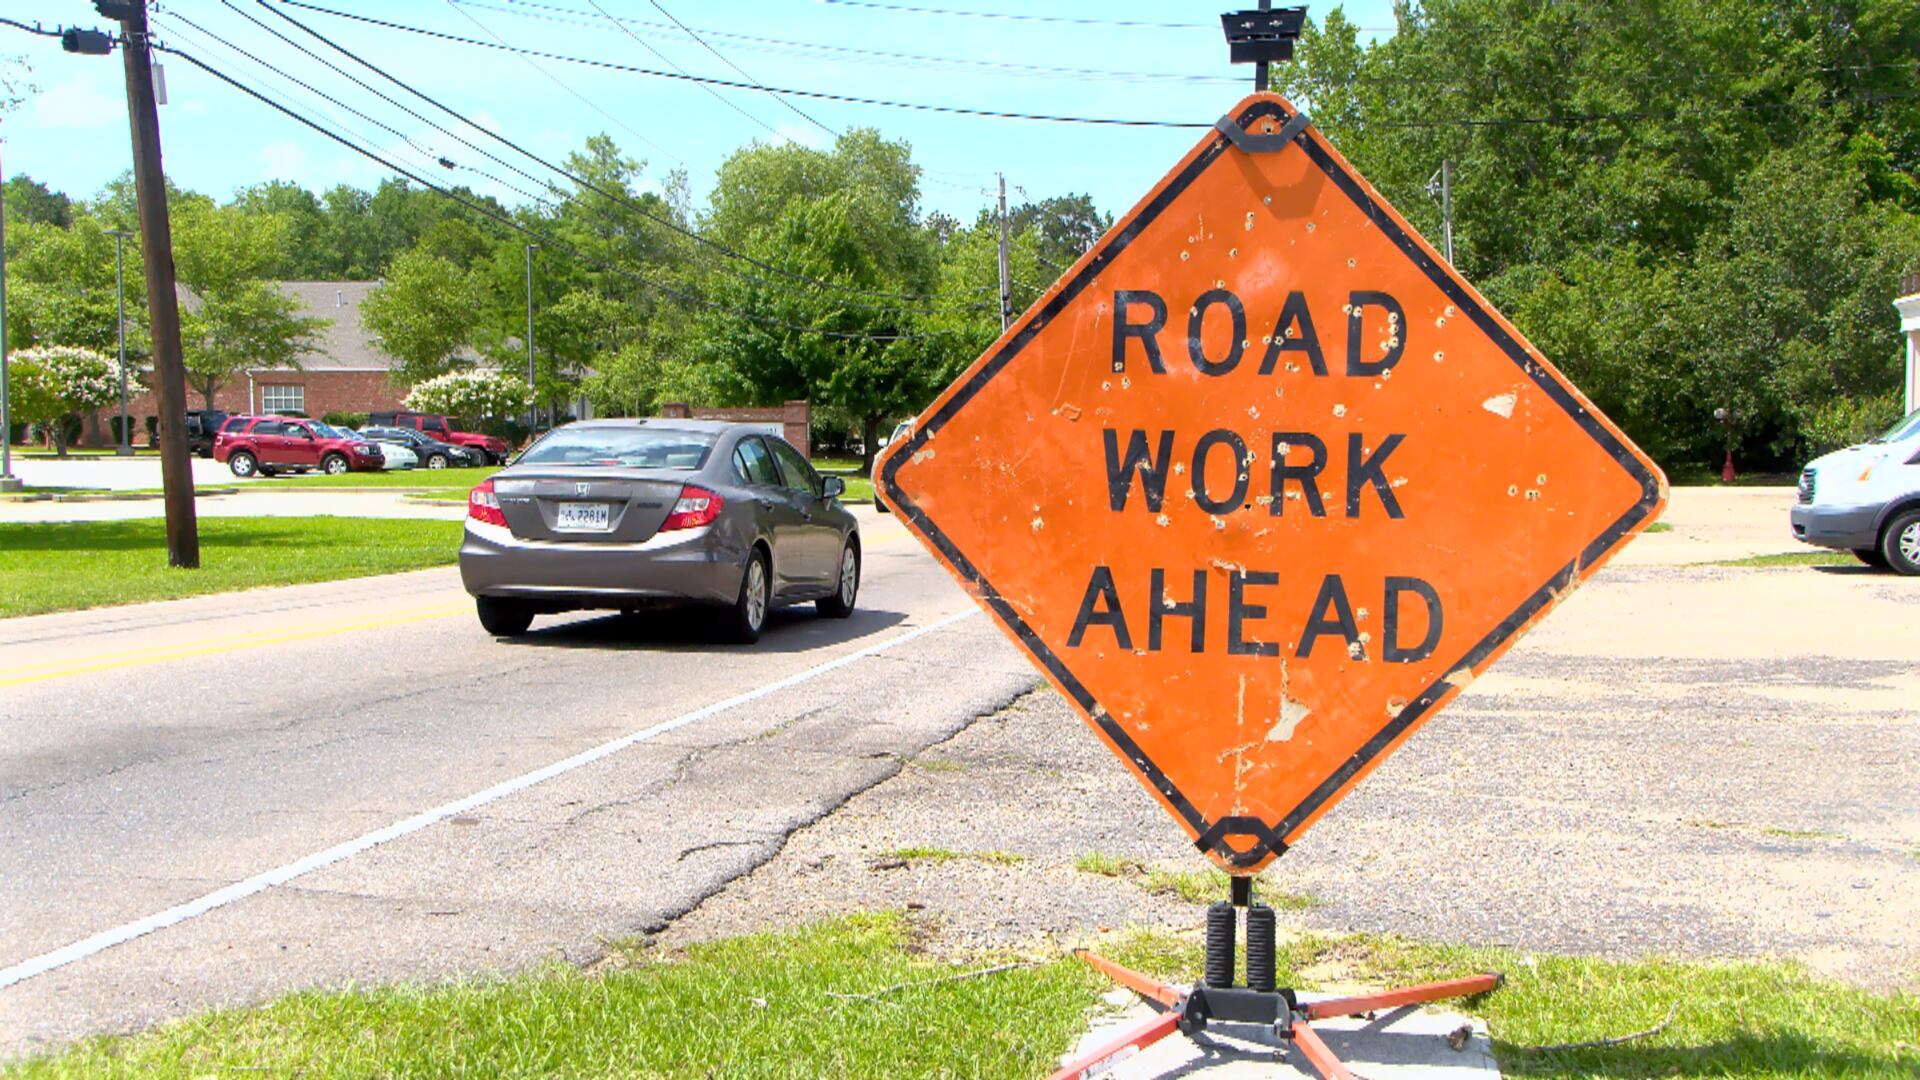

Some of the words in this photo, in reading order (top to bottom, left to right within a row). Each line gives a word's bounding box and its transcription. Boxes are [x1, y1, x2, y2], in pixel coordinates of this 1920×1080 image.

[1111, 288, 1407, 377] ROAD
[1103, 428, 1406, 519] WORK
[1066, 565, 1443, 662] AHEAD
